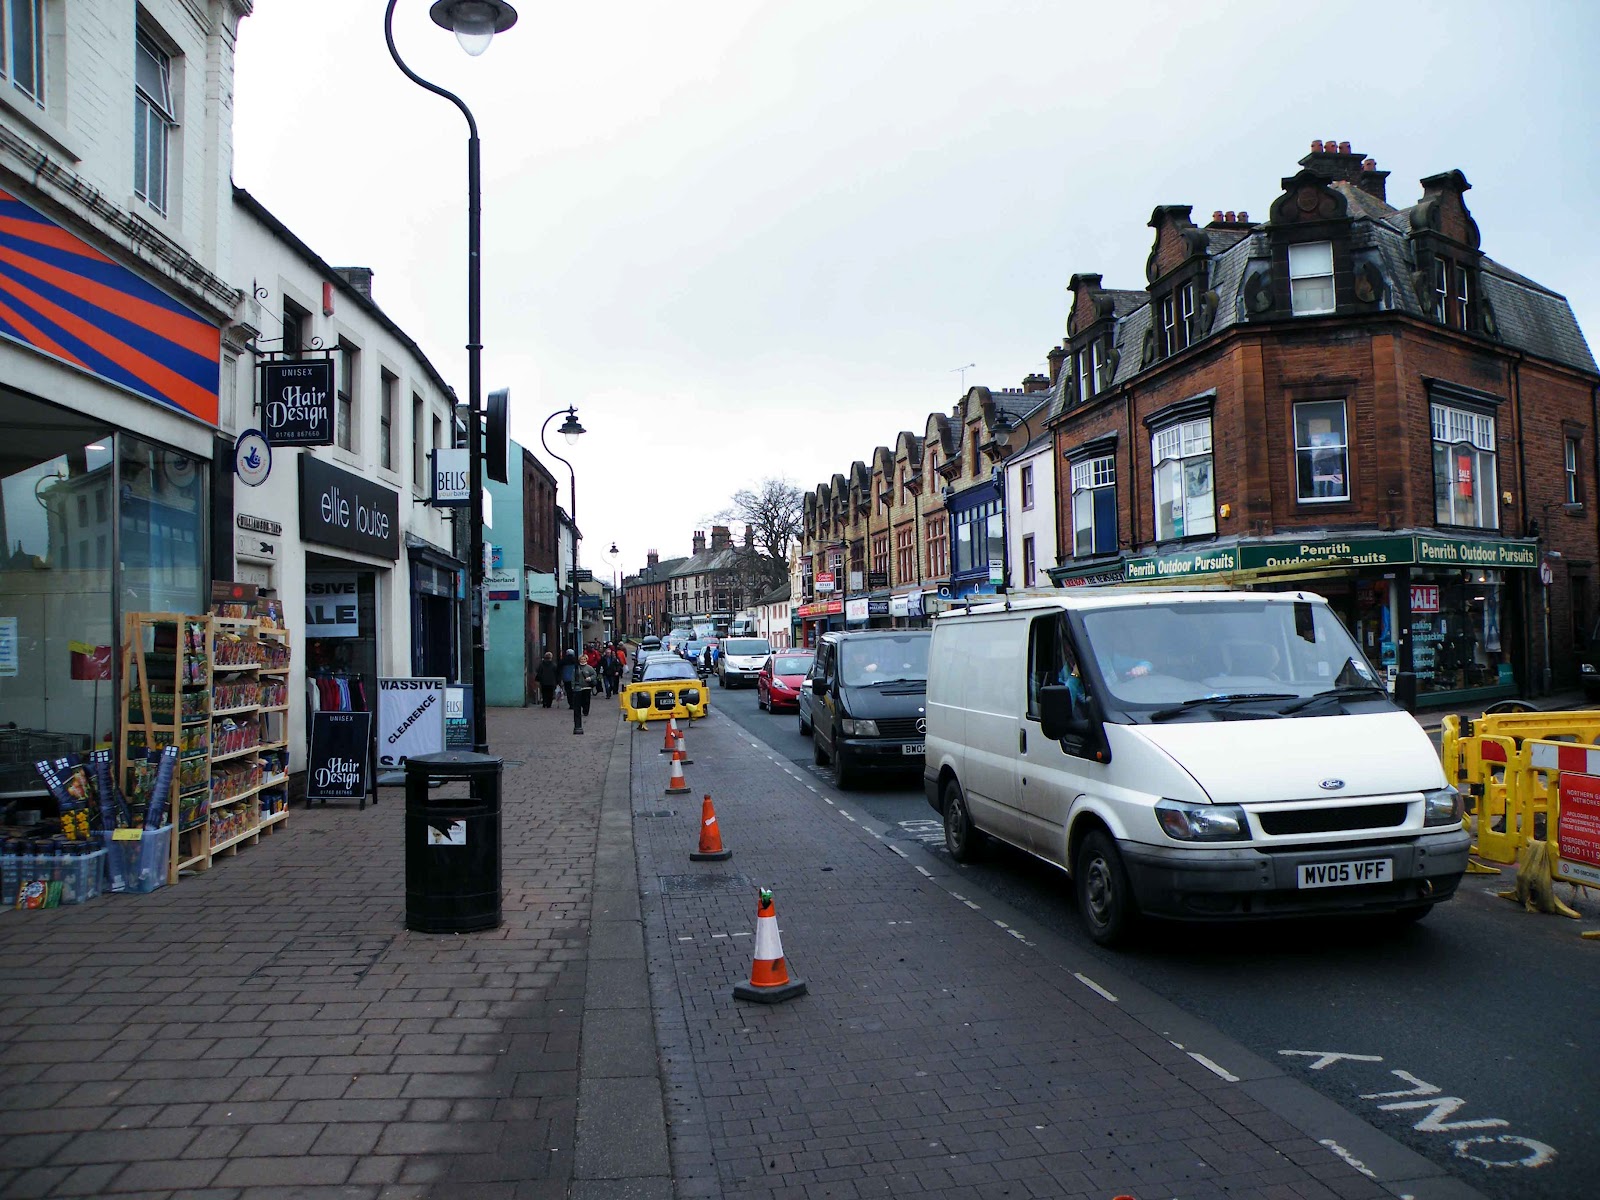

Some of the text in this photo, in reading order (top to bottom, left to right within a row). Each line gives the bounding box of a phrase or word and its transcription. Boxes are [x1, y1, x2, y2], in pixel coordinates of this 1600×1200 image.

[282, 368, 313, 377] UNISEX
[282, 386, 326, 407] Hair
[266, 401, 328, 429] Design
[438, 471, 466, 490] BELLS
[321, 486, 390, 540] ellie louise
[1300, 543, 1351, 555] Penrith
[1421, 542, 1534, 563] Penrith Outdoor Pursuits
[1128, 553, 1234, 576] Penrith Outdoor Pursuits
[1415, 669, 1435, 679] amping
[380, 680, 442, 690] MASSIVE
[446, 700, 460, 713] ELLS
[388, 694, 436, 744] CLEARENCE
[328, 757, 360, 773] Hair
[315, 768, 360, 790] Design
[1566, 789, 1593, 799] NORTHERN
[1572, 797, 1600, 806] NETWORKS
[1561, 835, 1590, 847] EMERGENCY
[1562, 844, 1581, 855] 0800
[1305, 861, 1386, 884] MV05 VFF
